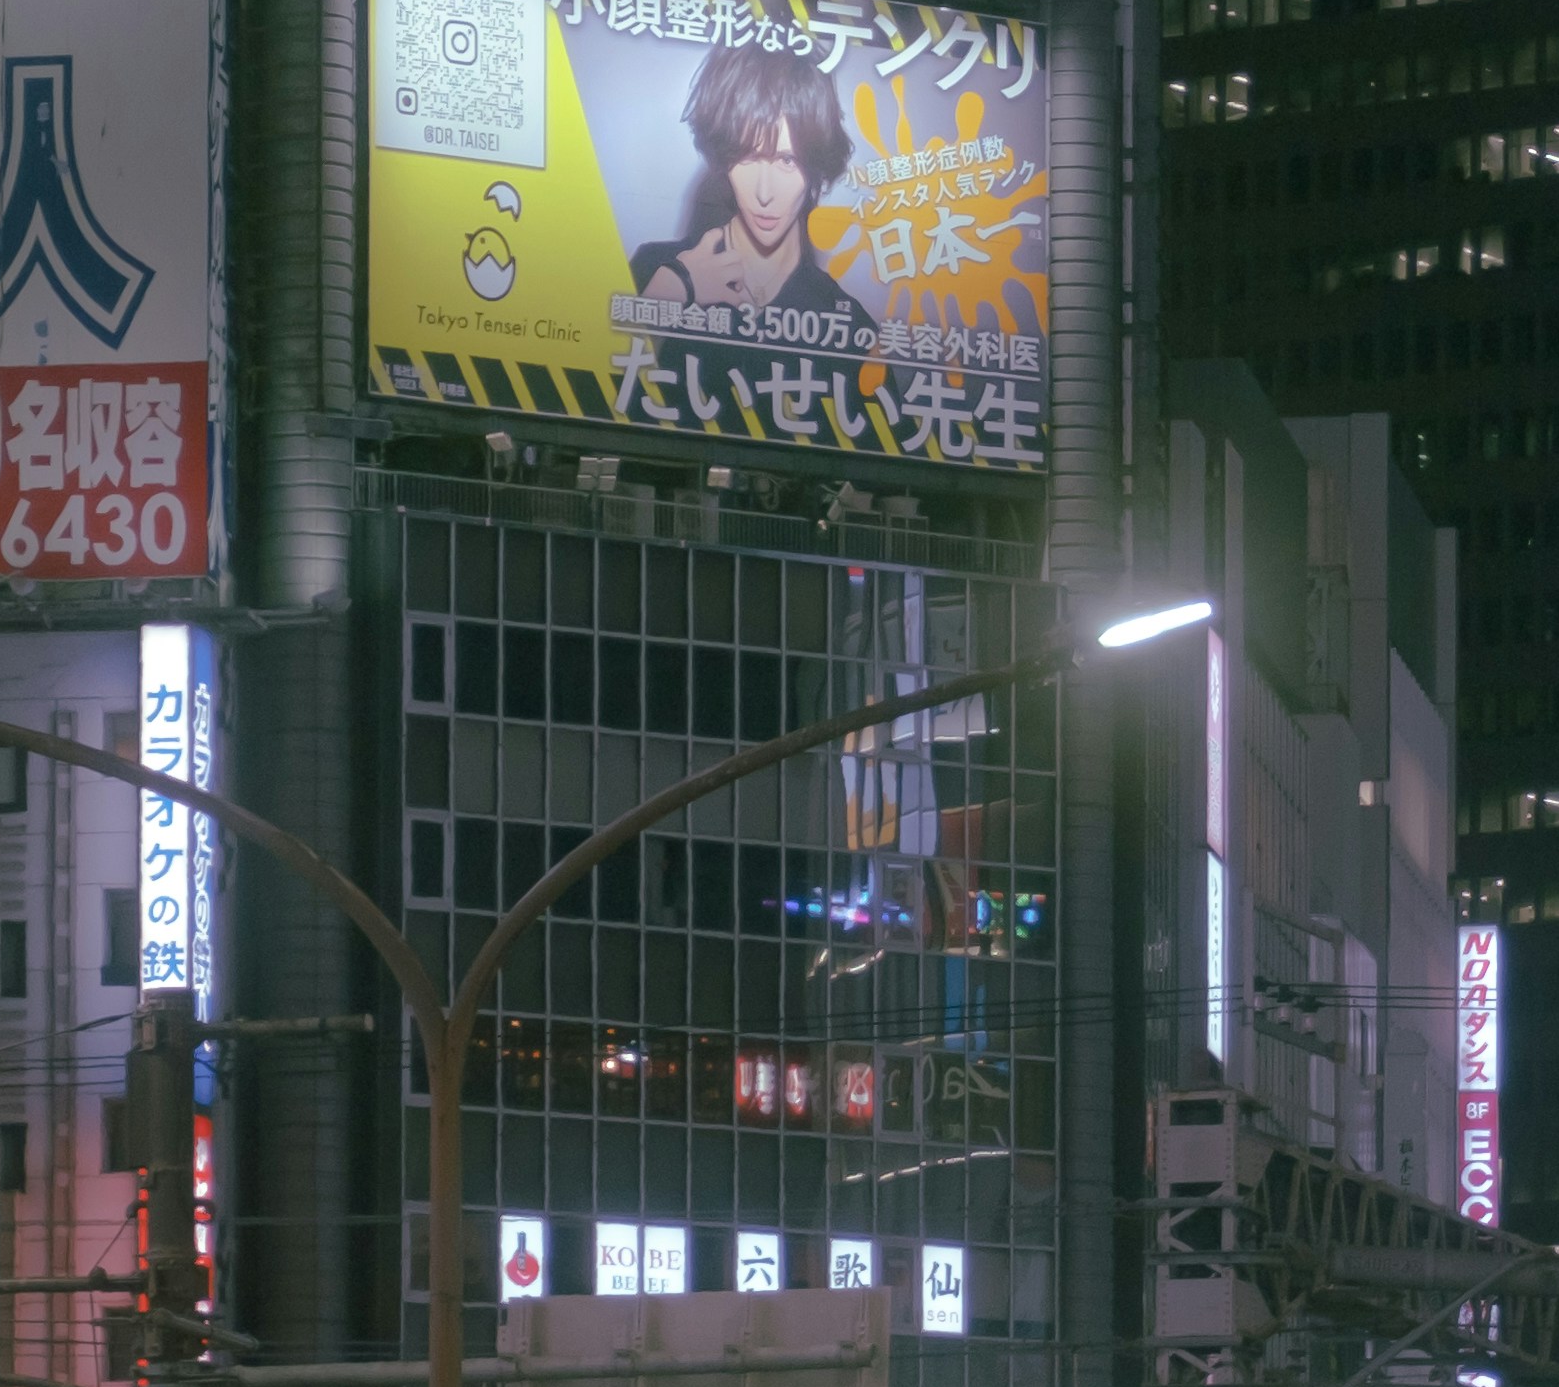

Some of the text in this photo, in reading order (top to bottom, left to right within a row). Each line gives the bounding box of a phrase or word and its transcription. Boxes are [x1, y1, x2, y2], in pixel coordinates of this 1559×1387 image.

[846, 134, 1007, 189] 小顔整形症例数
[851, 160, 1035, 219] インスタ人気ランク
[867, 206, 1041, 284] 日本一
[417, 305, 581, 344] Tokyo Tensei Clinic
[611, 294, 1041, 372] 顔面課金額 3,500万の美容外科医
[611, 336, 1044, 462] たいせい先生
[1460, 931, 1494, 1084] NOAダンス
[1465, 1102, 1489, 1120] 8F
[600, 1244, 681, 1270] KOBE
[926, 1311, 960, 1325] sen
